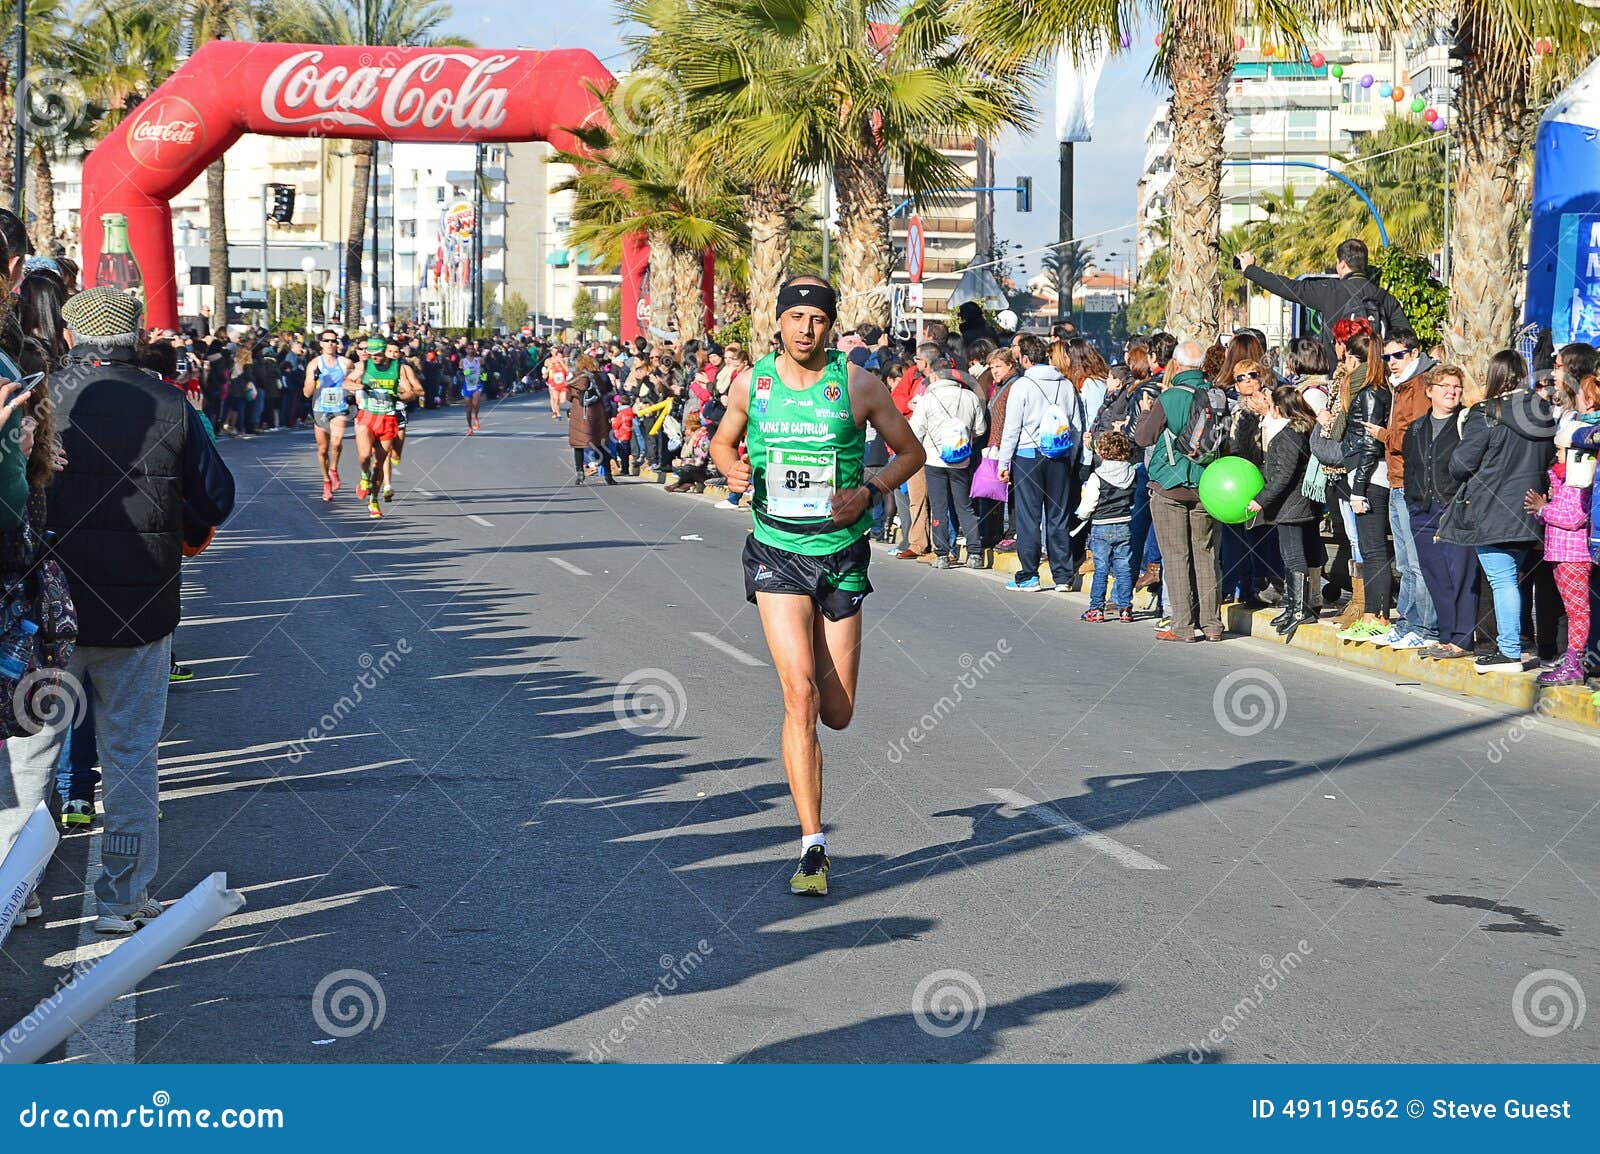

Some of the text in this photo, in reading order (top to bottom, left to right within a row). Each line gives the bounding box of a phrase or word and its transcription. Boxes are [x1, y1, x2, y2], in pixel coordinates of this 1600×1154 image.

[261, 50, 520, 130] Coca-Cola
[133, 120, 200, 144] Coca-Cola
[780, 422, 789, 433] DE
[11, 881, 29, 904] POLA
